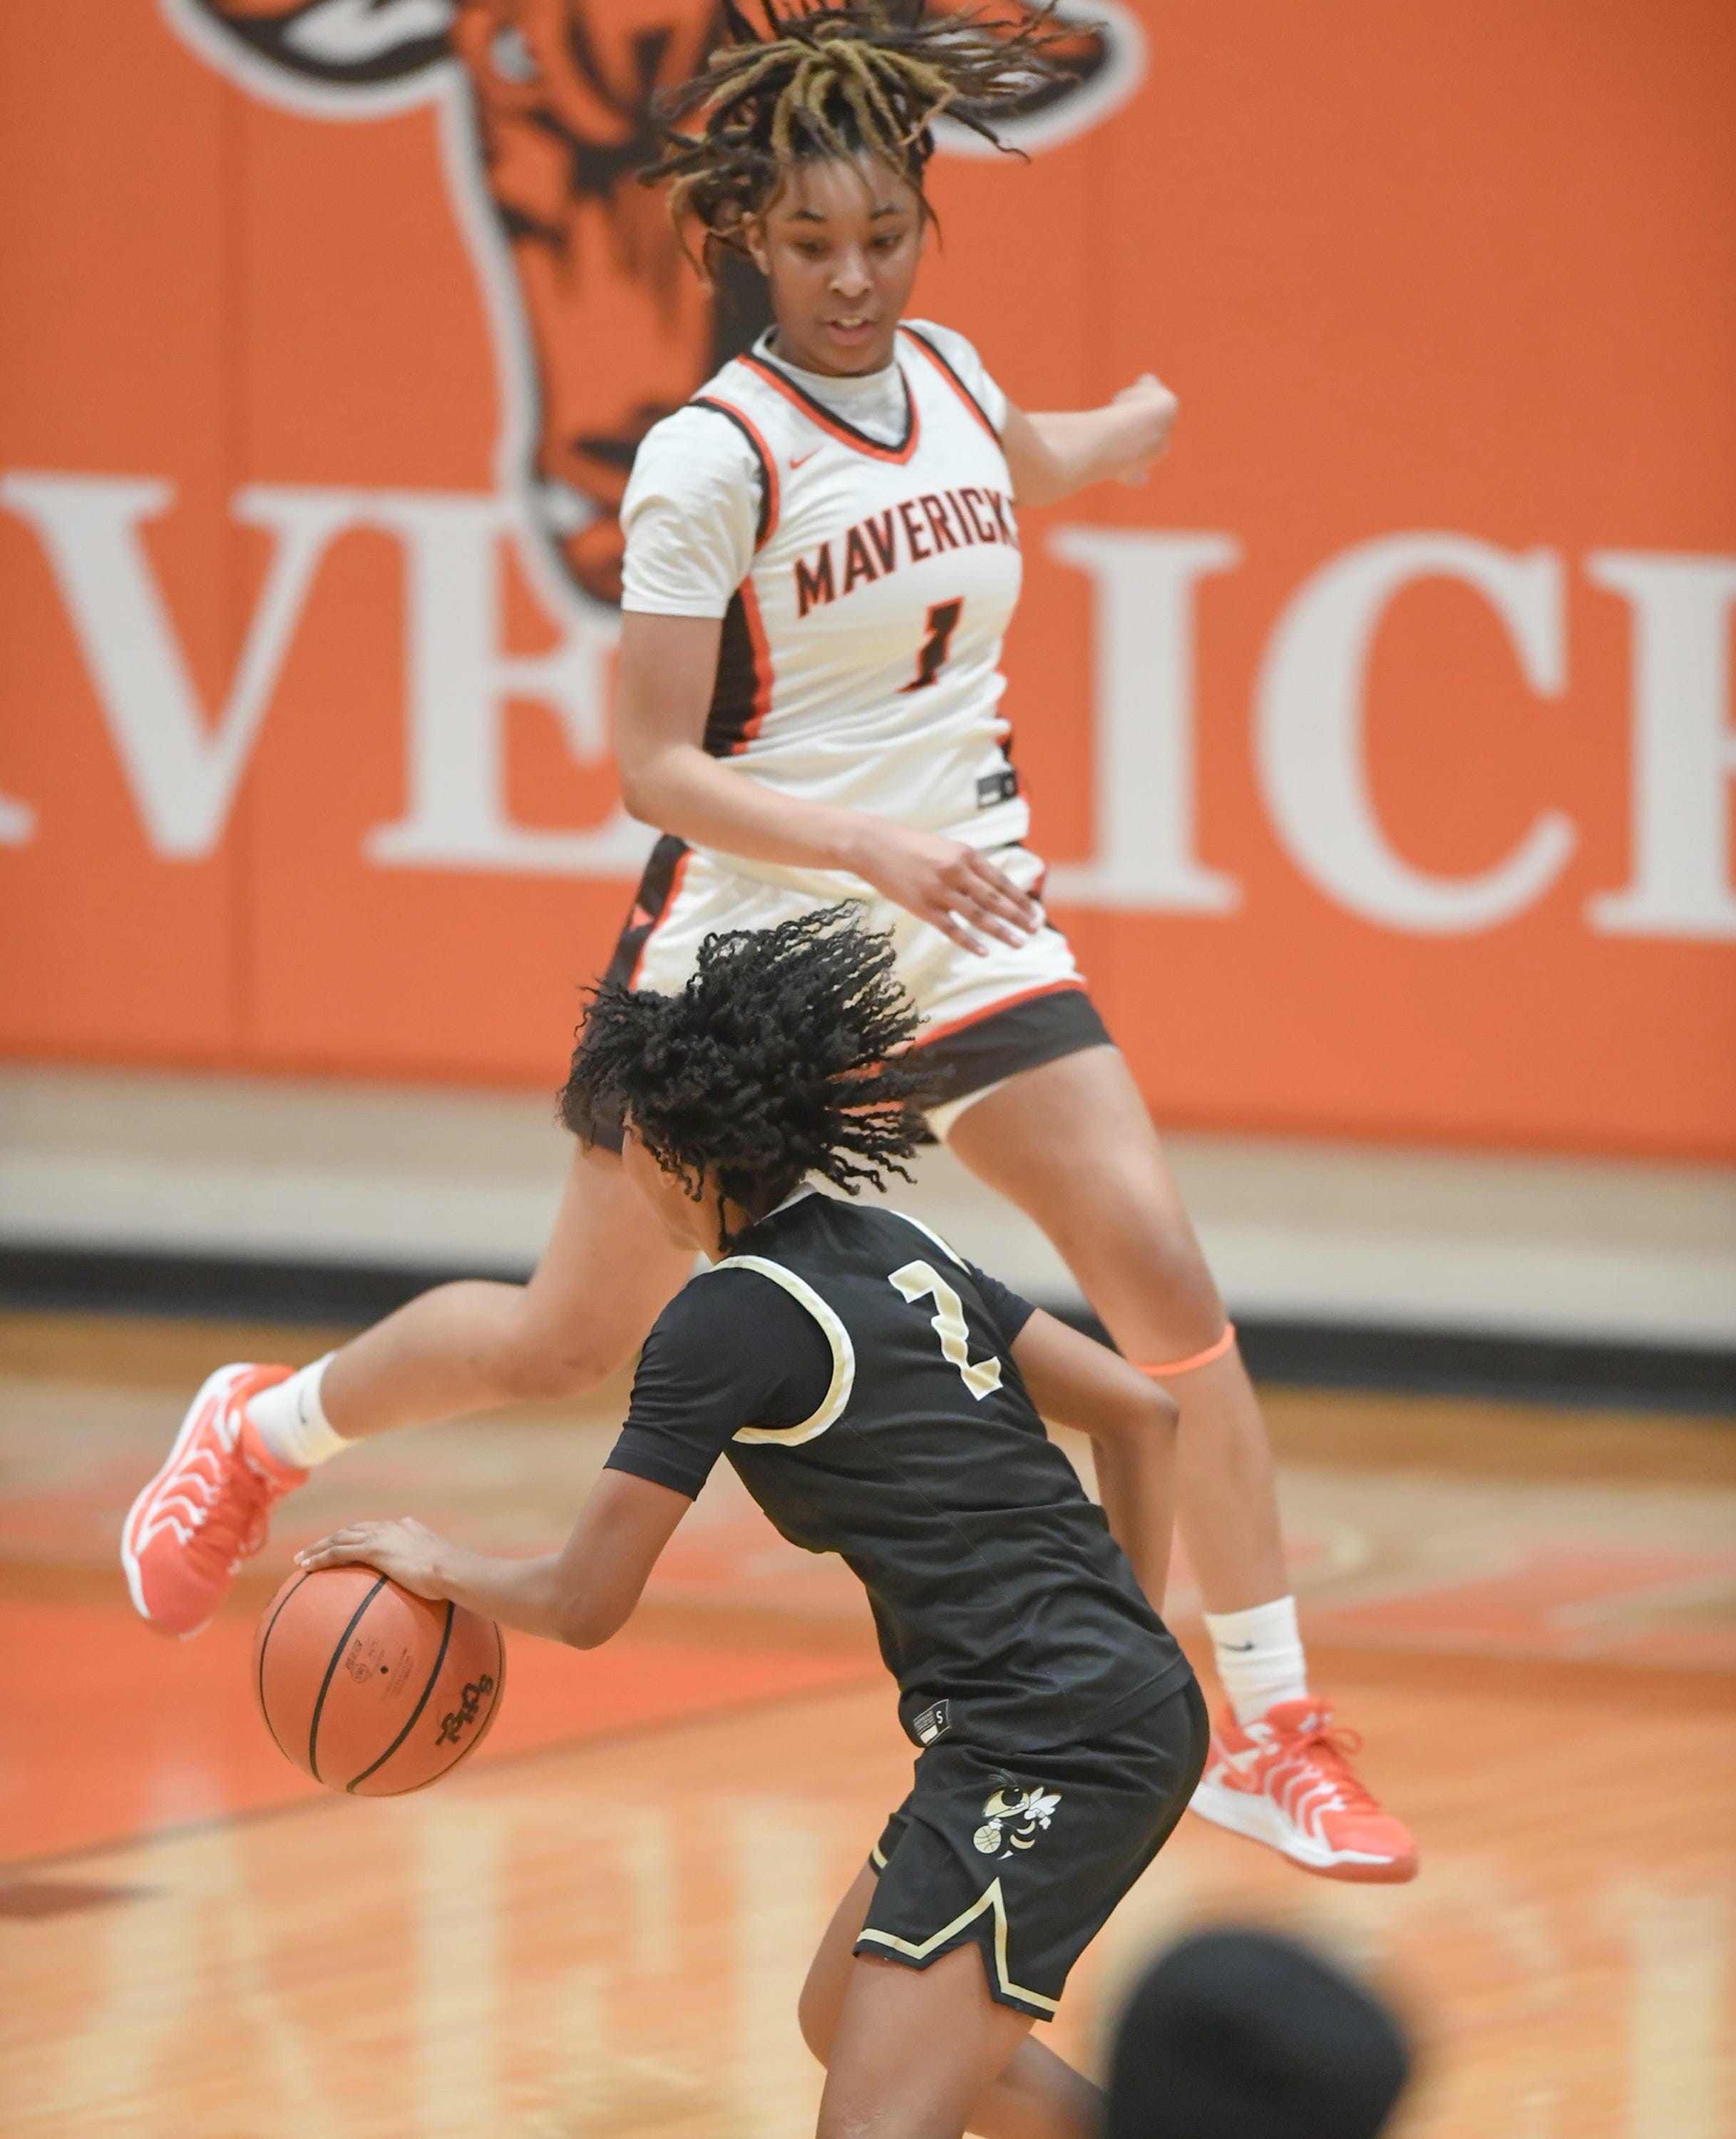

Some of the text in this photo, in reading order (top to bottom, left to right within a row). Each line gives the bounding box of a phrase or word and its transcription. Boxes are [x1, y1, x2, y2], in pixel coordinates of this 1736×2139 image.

[793, 486, 1017, 620] MAVERICK
[896, 595, 965, 694] 1
[888, 1259, 1003, 1402] 2
[936, 1710, 943, 1724] S
